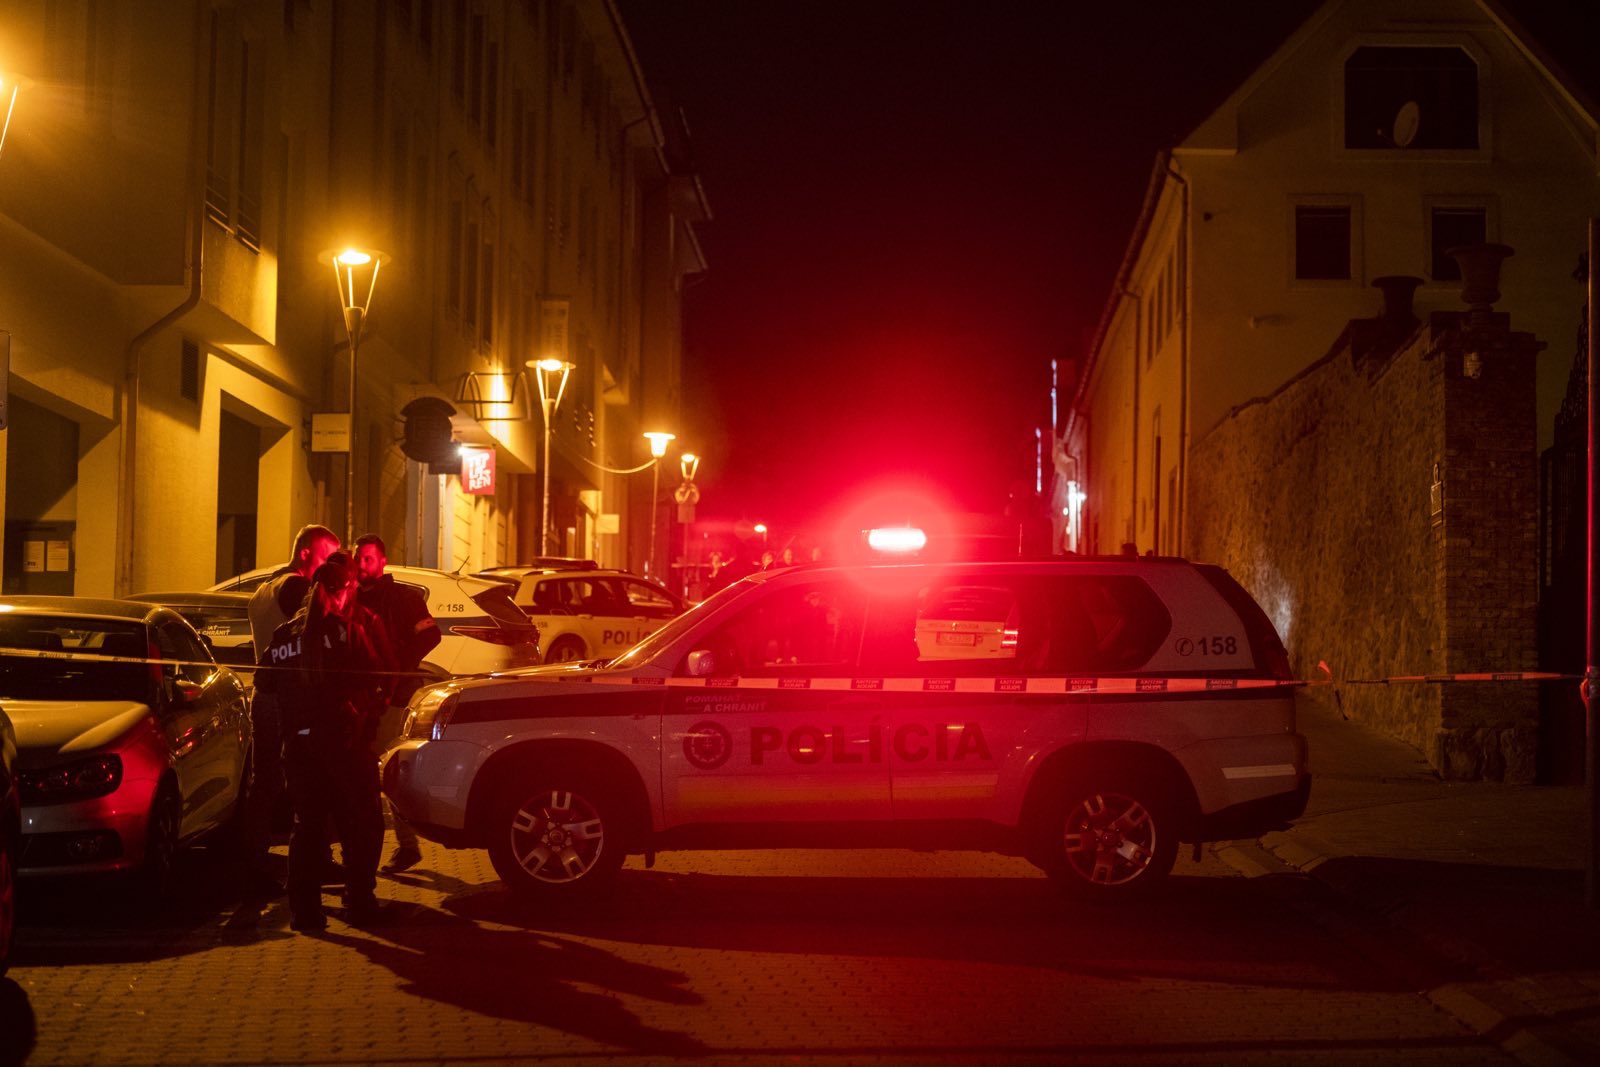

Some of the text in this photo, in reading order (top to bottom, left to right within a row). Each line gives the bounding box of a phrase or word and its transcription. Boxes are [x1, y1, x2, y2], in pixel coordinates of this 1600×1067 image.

[447, 604, 464, 612] 158
[602, 627, 652, 645] POLÍC
[1198, 636, 1238, 656] 158
[703, 704, 712, 712] A
[750, 714, 993, 766] POLÍCIA
